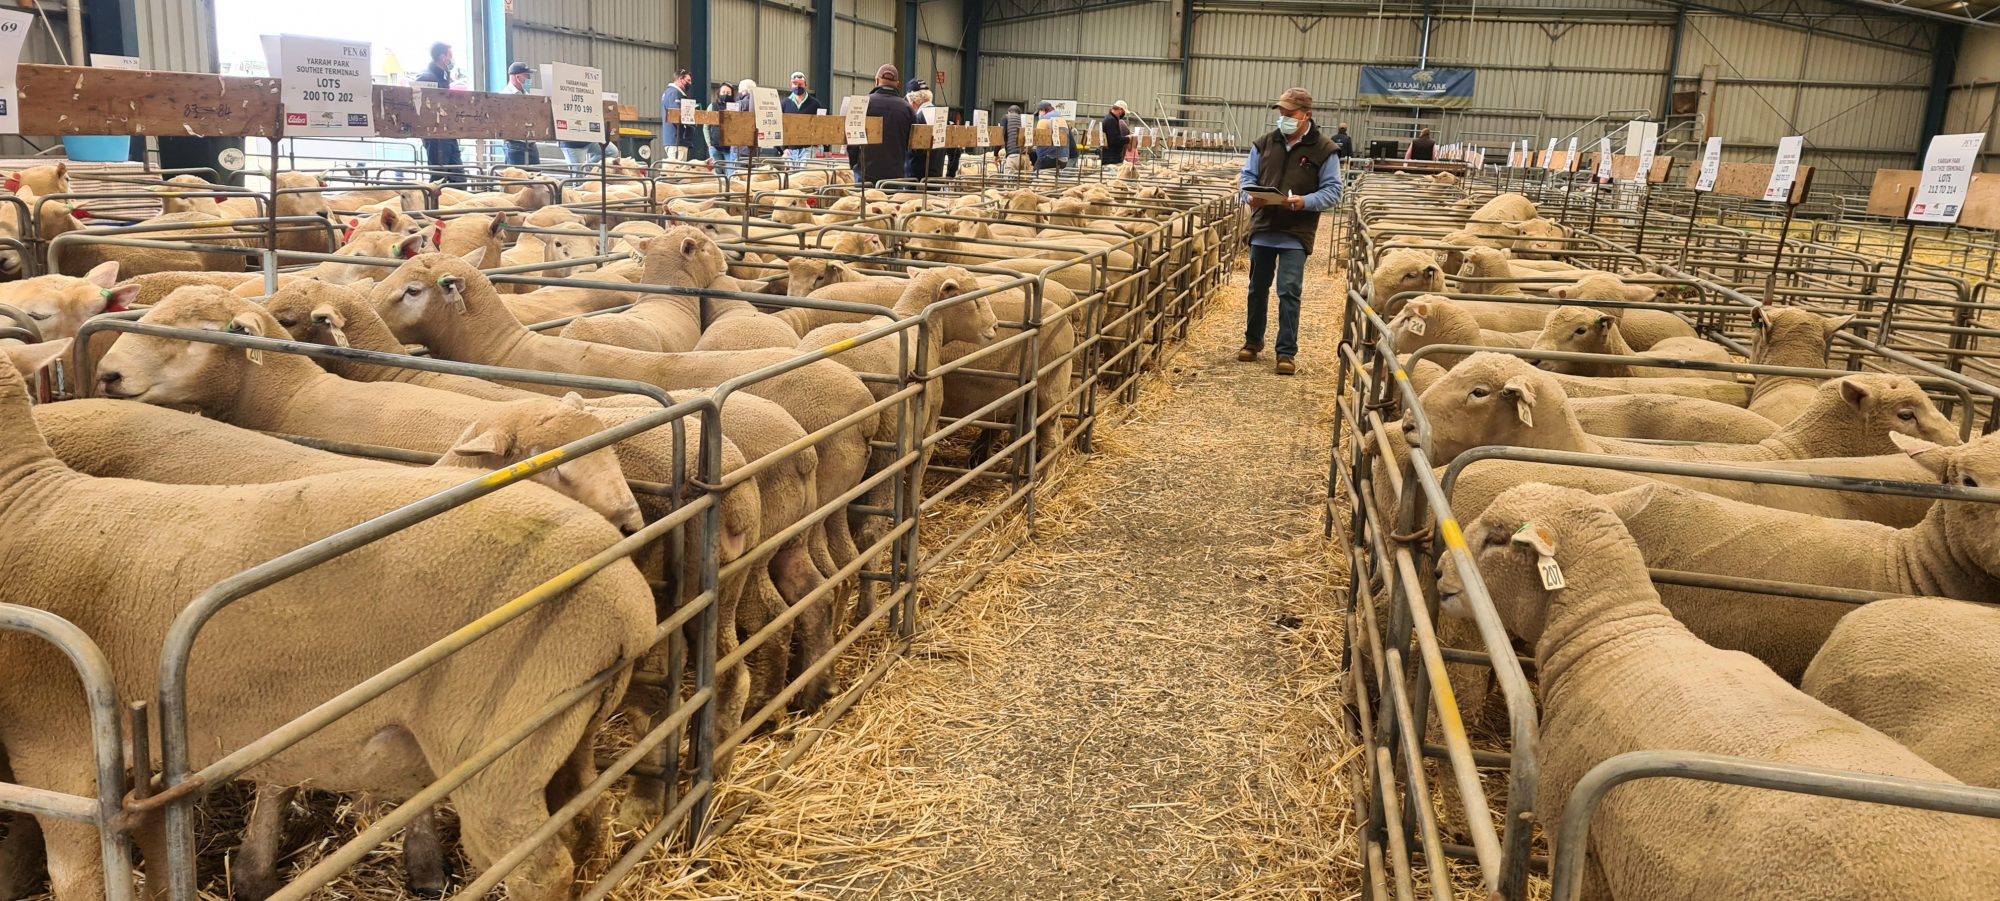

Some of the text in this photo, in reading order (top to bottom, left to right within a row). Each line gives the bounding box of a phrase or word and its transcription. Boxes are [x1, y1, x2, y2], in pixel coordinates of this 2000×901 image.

[1, 22, 17, 32] 69
[343, 46, 367, 57] PEN 68
[307, 57, 331, 66] YARRAM
[296, 65, 359, 76] SOUTHIE TERMINALS
[317, 78, 340, 88] LOTS
[1427, 82, 1447, 90] PARK
[303, 90, 353, 102] 200 TO 202
[571, 94, 583, 103] LOTS
[563, 103, 592, 113] 197 TO 199
[1938, 173, 1952, 182] LOTS
[1928, 185, 1957, 194] 212 TO 214
[1542, 564, 1562, 587] 207
